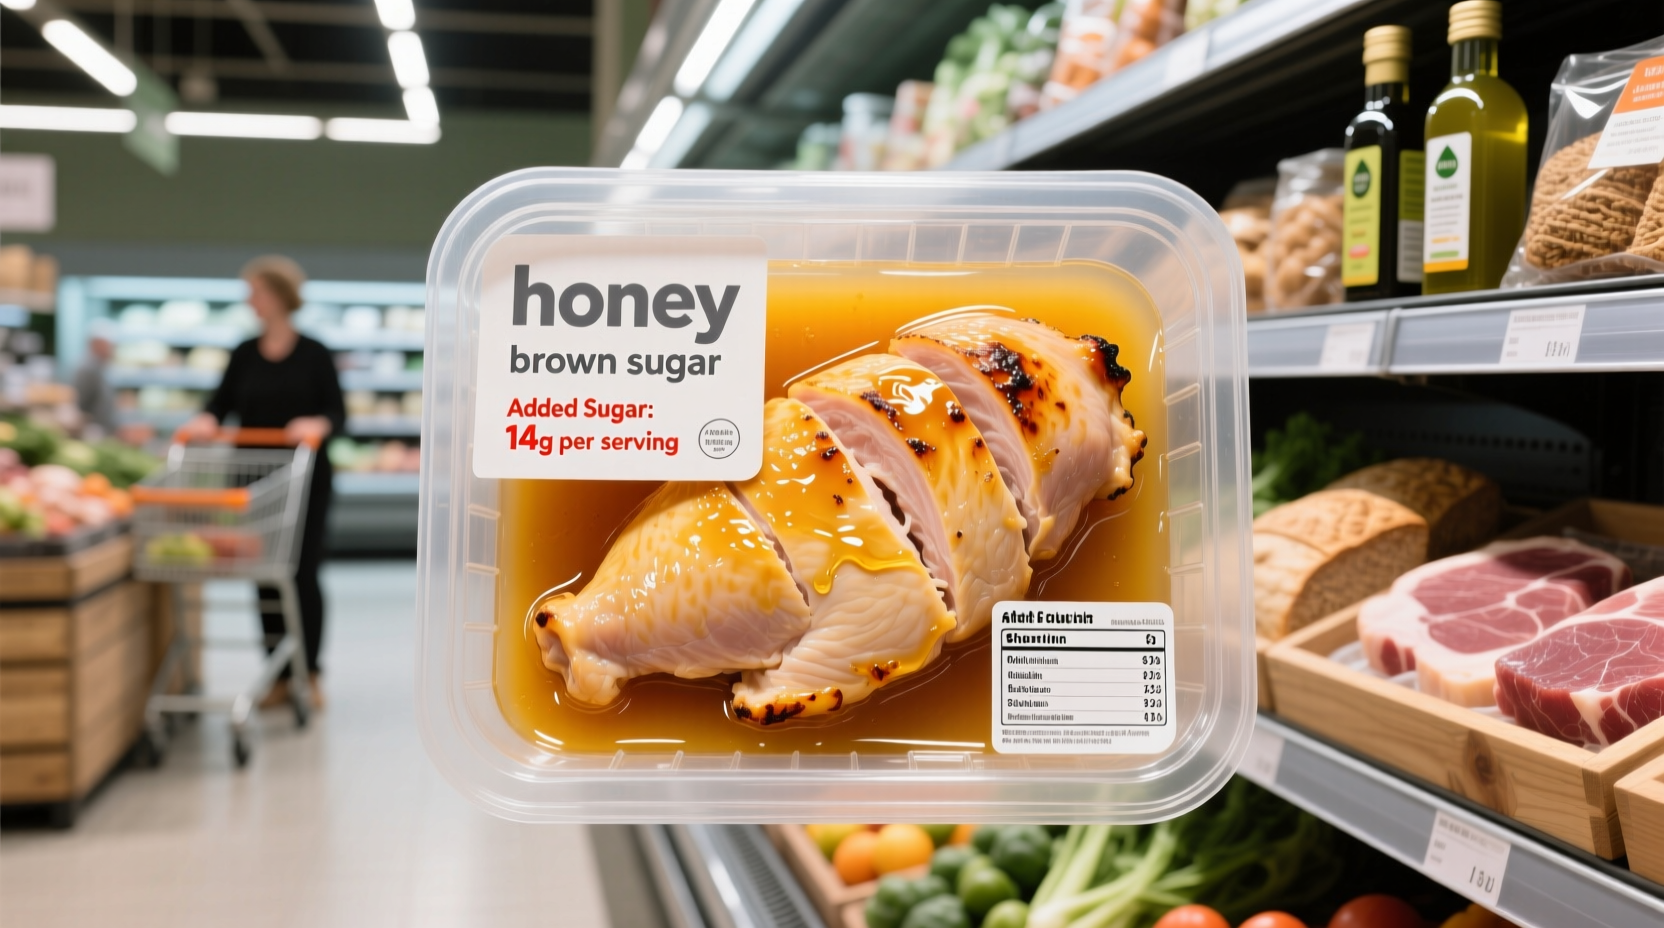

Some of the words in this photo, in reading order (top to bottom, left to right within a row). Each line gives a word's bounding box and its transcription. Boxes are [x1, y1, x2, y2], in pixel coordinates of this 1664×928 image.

[512, 264, 741, 344] honey
[510, 345, 617, 374] brown
[627, 353, 722, 383] sugar
[507, 397, 578, 418] Added
[583, 397, 654, 424] Sugar:
[505, 424, 553, 456] 14g
[559, 435, 595, 456] per
[600, 430, 679, 456] serving
